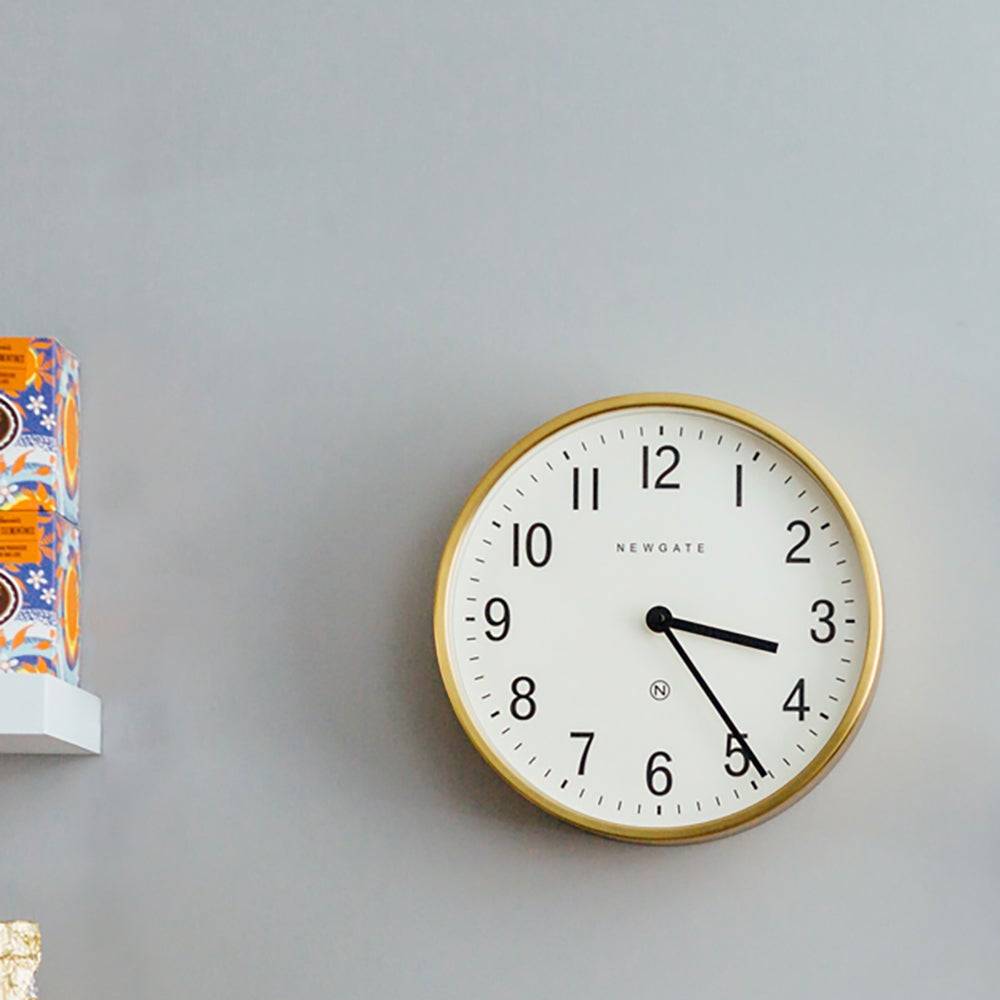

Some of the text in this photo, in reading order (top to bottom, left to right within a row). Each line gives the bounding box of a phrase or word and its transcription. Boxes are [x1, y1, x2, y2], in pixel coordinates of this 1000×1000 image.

[572, 467, 599, 511] 11
[642, 445, 681, 489] 12
[735, 464, 743, 507] 1
[512, 522, 554, 568] 10
[616, 542, 707, 554] NEWGATE
[785, 519, 811, 564] 2
[484, 596, 511, 641] 9
[809, 599, 837, 644] 3
[509, 676, 537, 720] 8
[782, 677, 811, 722] 4
[569, 732, 595, 776] 7
[645, 751, 673, 796] 6
[724, 733, 752, 777] 5
